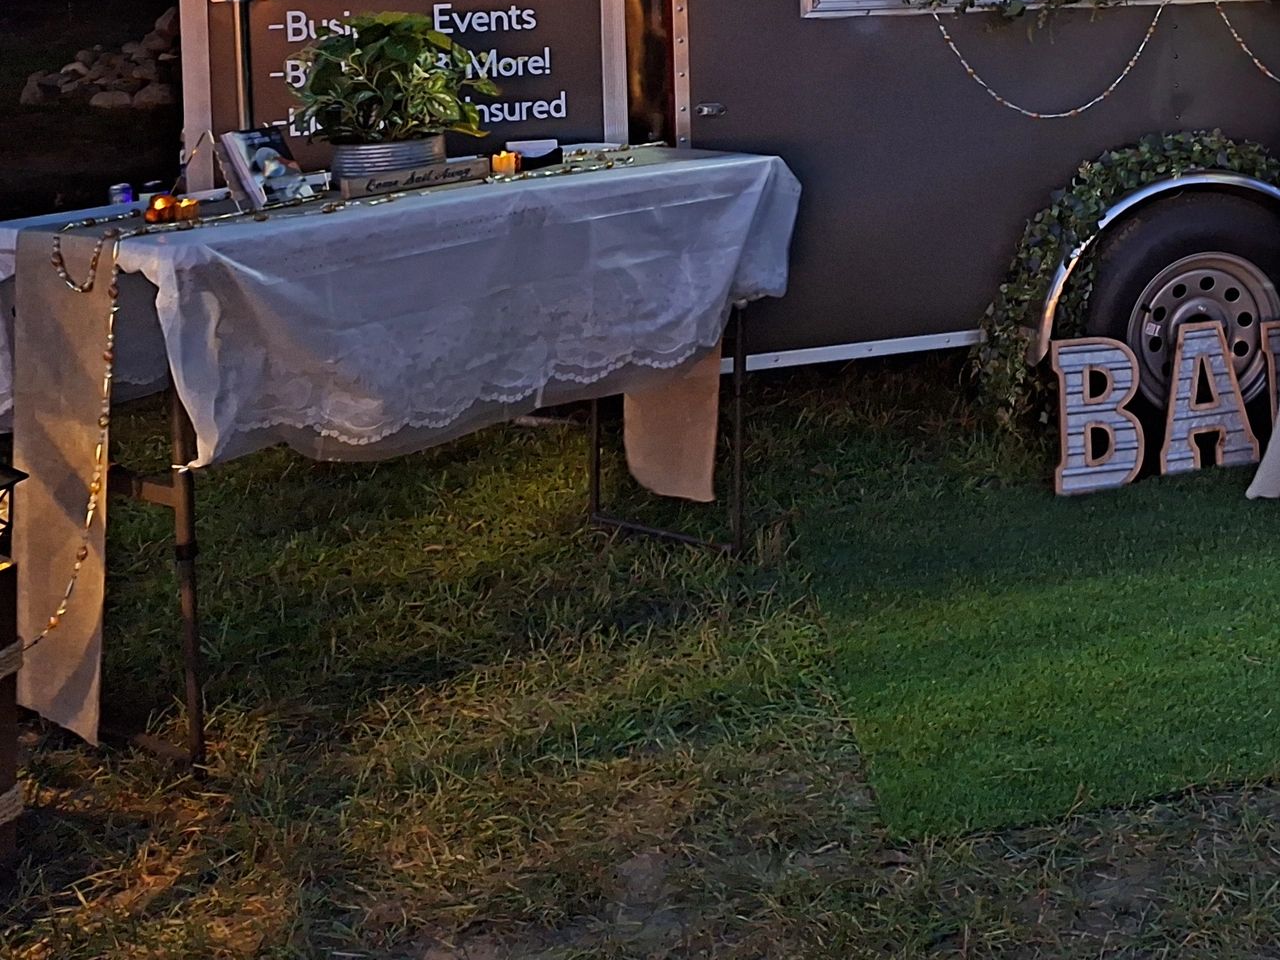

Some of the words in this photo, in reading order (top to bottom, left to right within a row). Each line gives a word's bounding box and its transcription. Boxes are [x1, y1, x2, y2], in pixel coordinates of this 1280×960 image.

[433, 3, 537, 34] Events
[465, 46, 551, 79] More!
[464, 90, 567, 123] nsured
